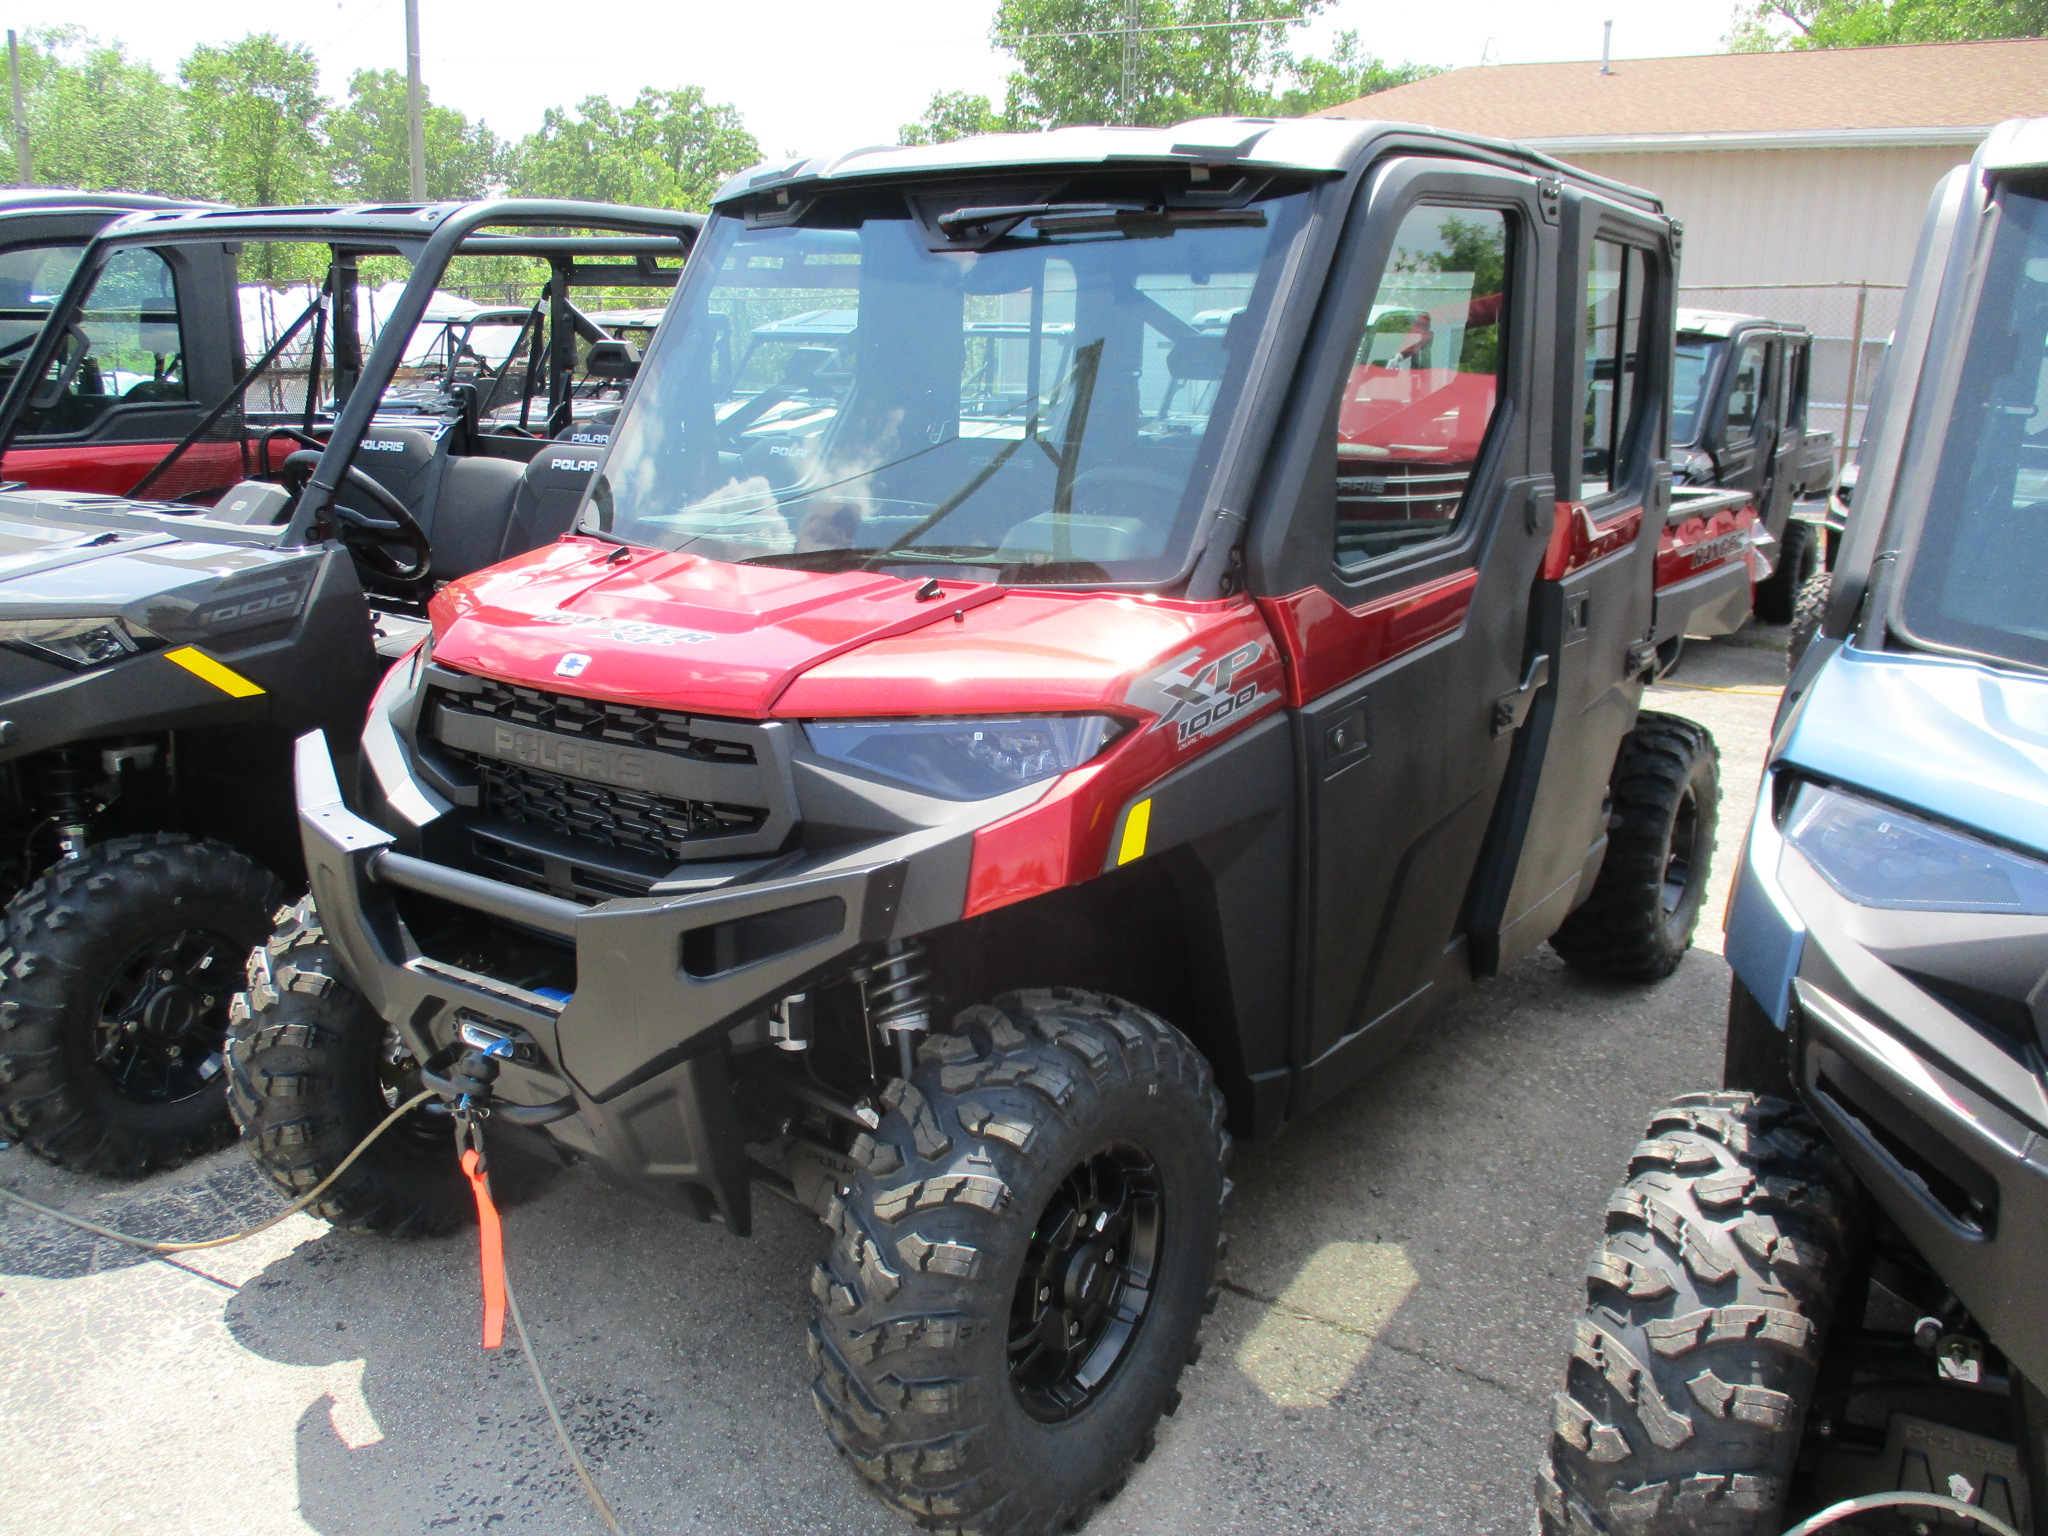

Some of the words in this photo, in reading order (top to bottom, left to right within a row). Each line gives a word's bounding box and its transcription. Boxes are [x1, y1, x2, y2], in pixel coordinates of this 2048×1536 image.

[1145, 639, 1263, 737] XP
[1177, 681, 1259, 745] 1000
[495, 726, 646, 785] POLARIS
